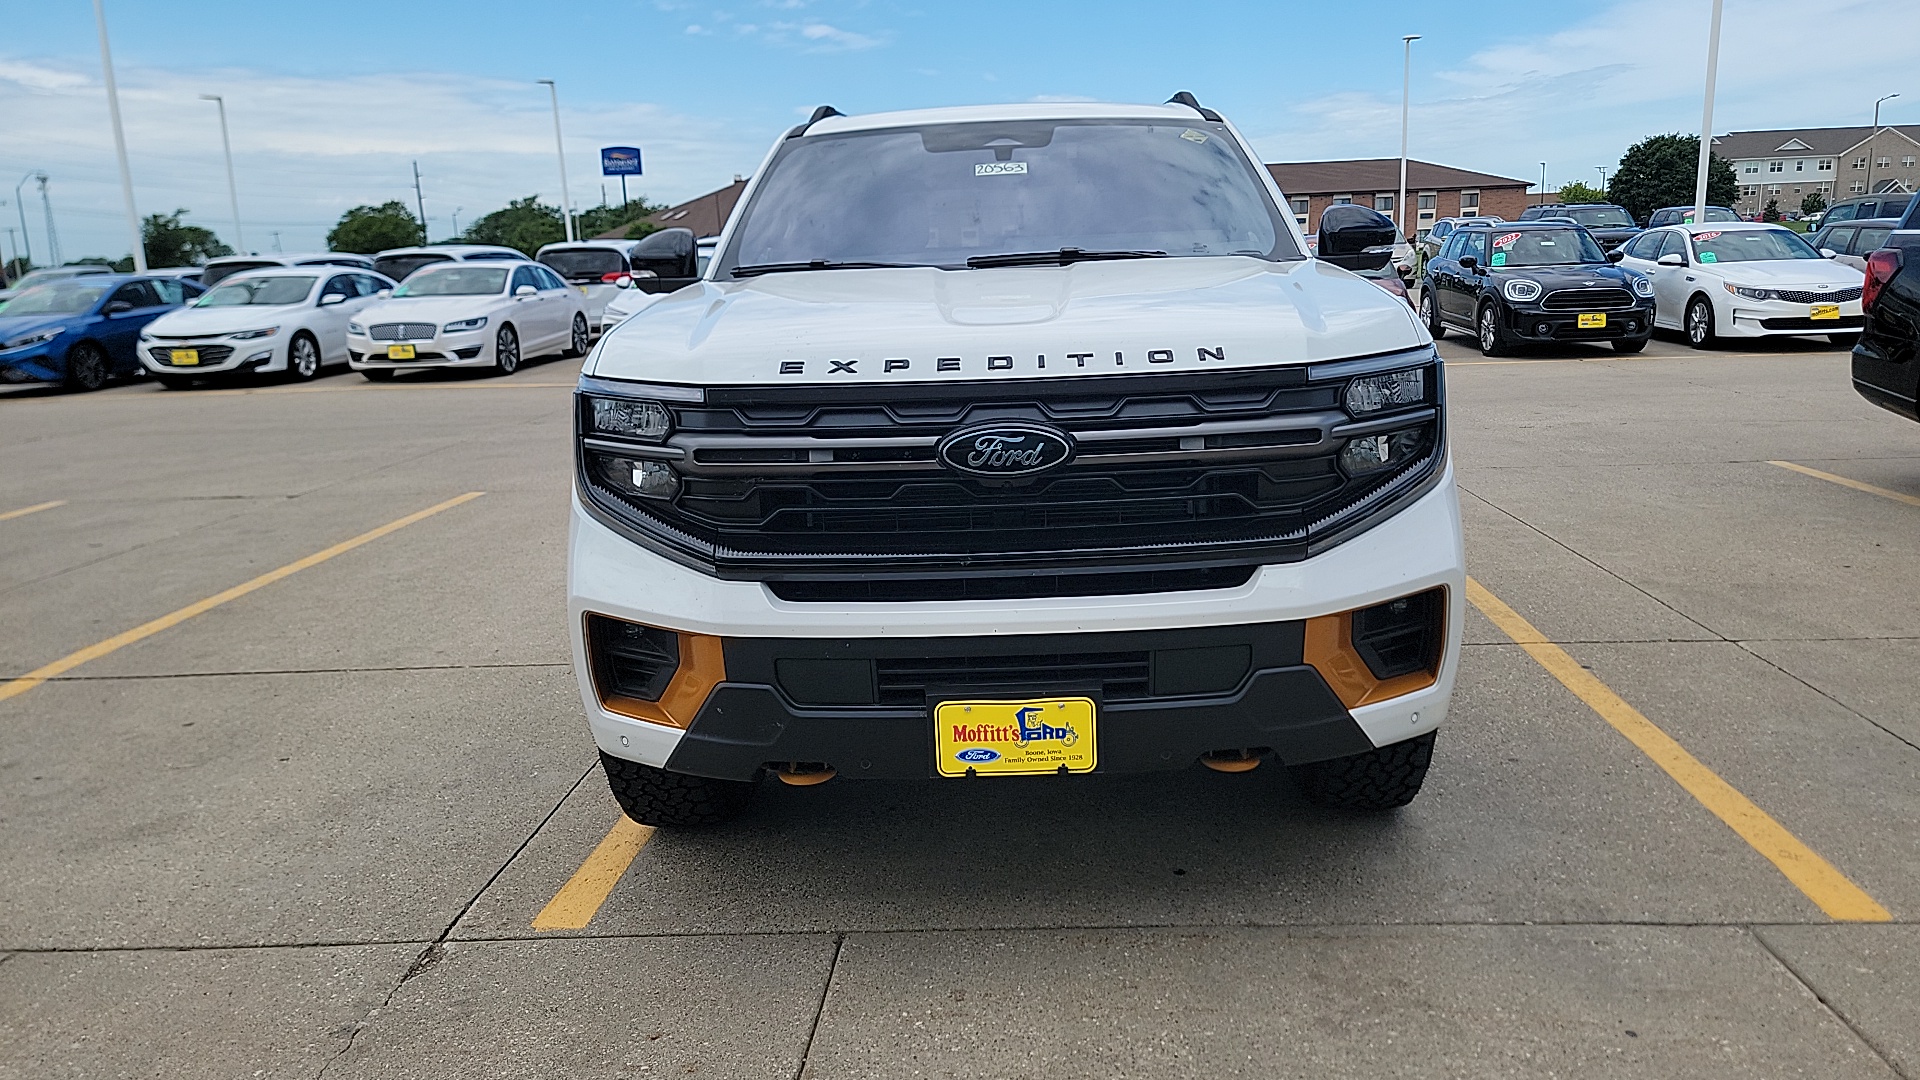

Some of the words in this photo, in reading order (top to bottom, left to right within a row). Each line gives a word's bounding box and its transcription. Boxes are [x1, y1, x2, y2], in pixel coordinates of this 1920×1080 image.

[977, 163, 1024, 174] 20563
[779, 346, 1225, 375] EXPEDITION
[967, 435, 1045, 467] Ford
[953, 724, 1019, 743] Moffitt's
[965, 750, 991, 760] Ford
